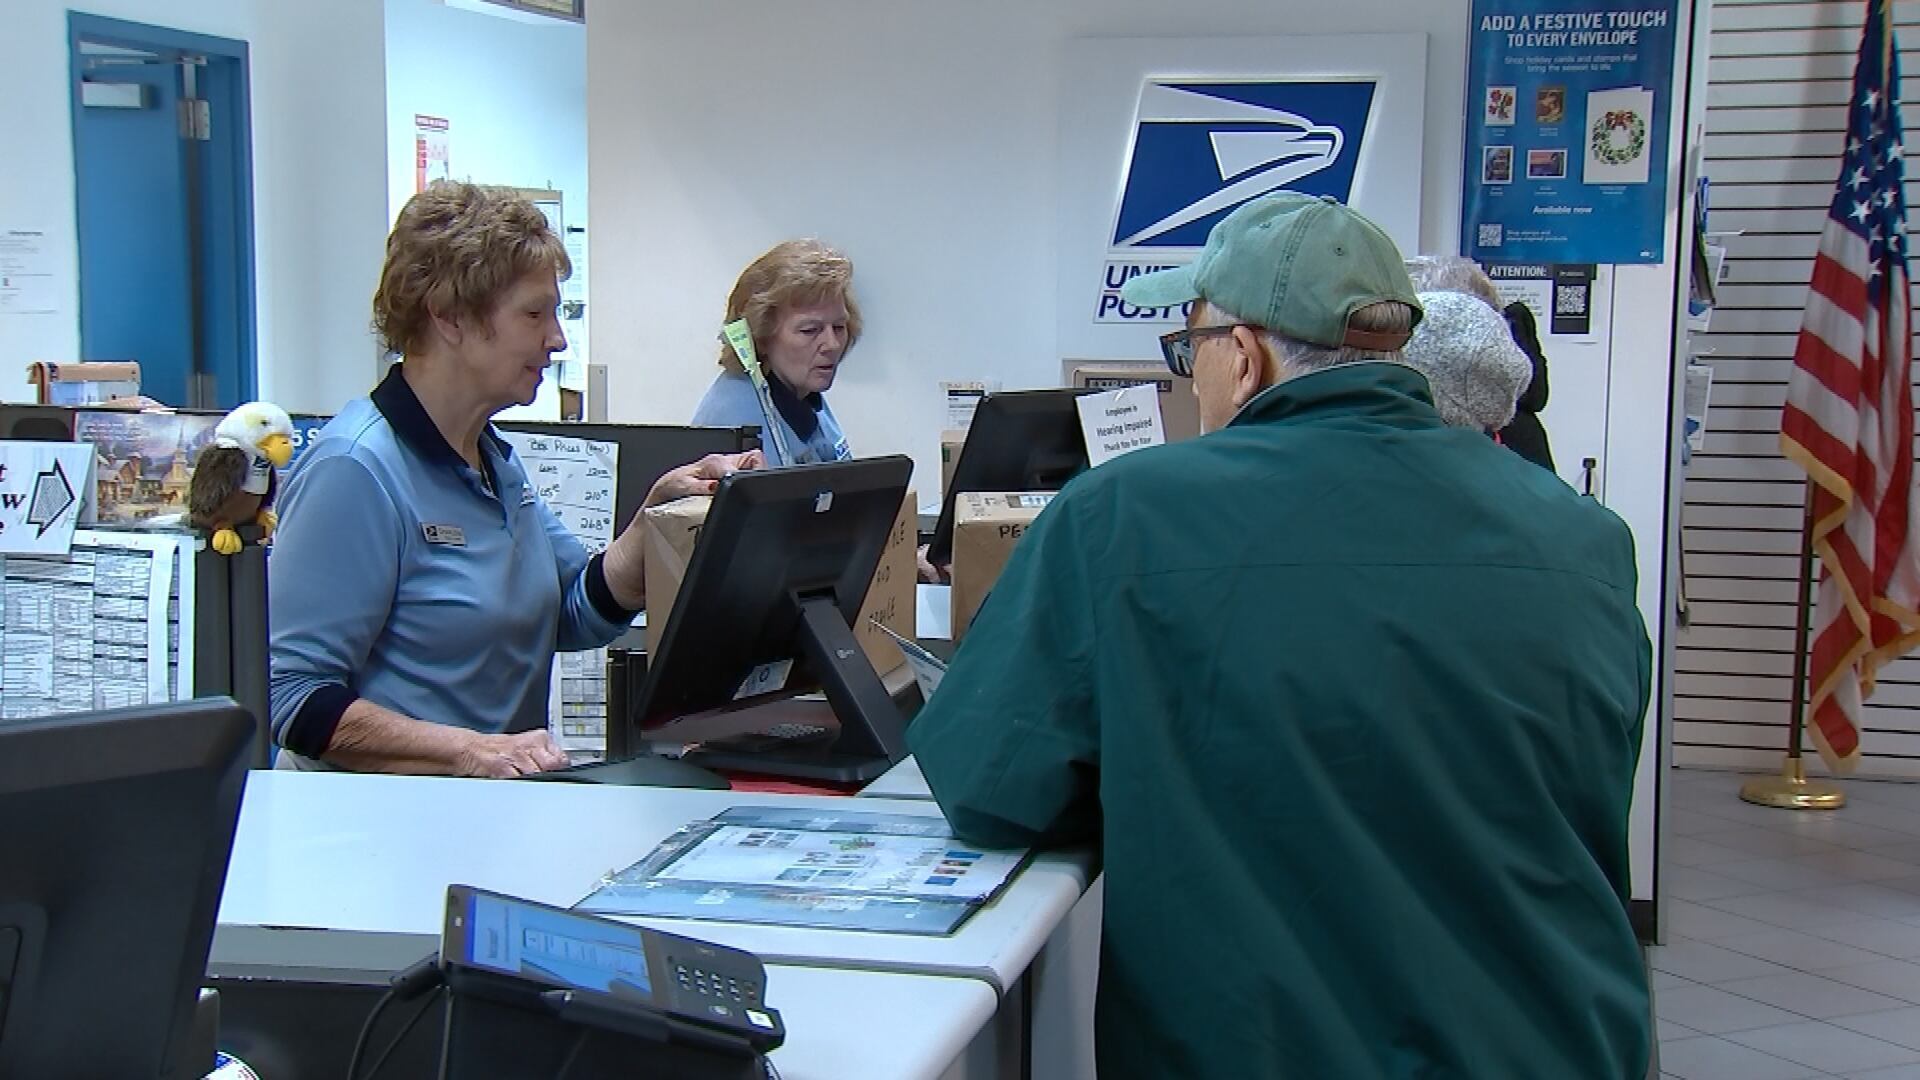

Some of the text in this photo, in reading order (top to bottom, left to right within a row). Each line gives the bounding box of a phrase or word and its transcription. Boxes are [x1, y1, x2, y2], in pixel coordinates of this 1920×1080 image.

[1481, 10, 1667, 31] ADD A FESTIVE TOUCH
[1508, 30, 1638, 48] TO EVERY ENVELOPE
[1532, 205, 1593, 215] Available now
[1489, 265, 1548, 277] ATTENTION:
[1096, 417, 1152, 437] Hearing Impaired
